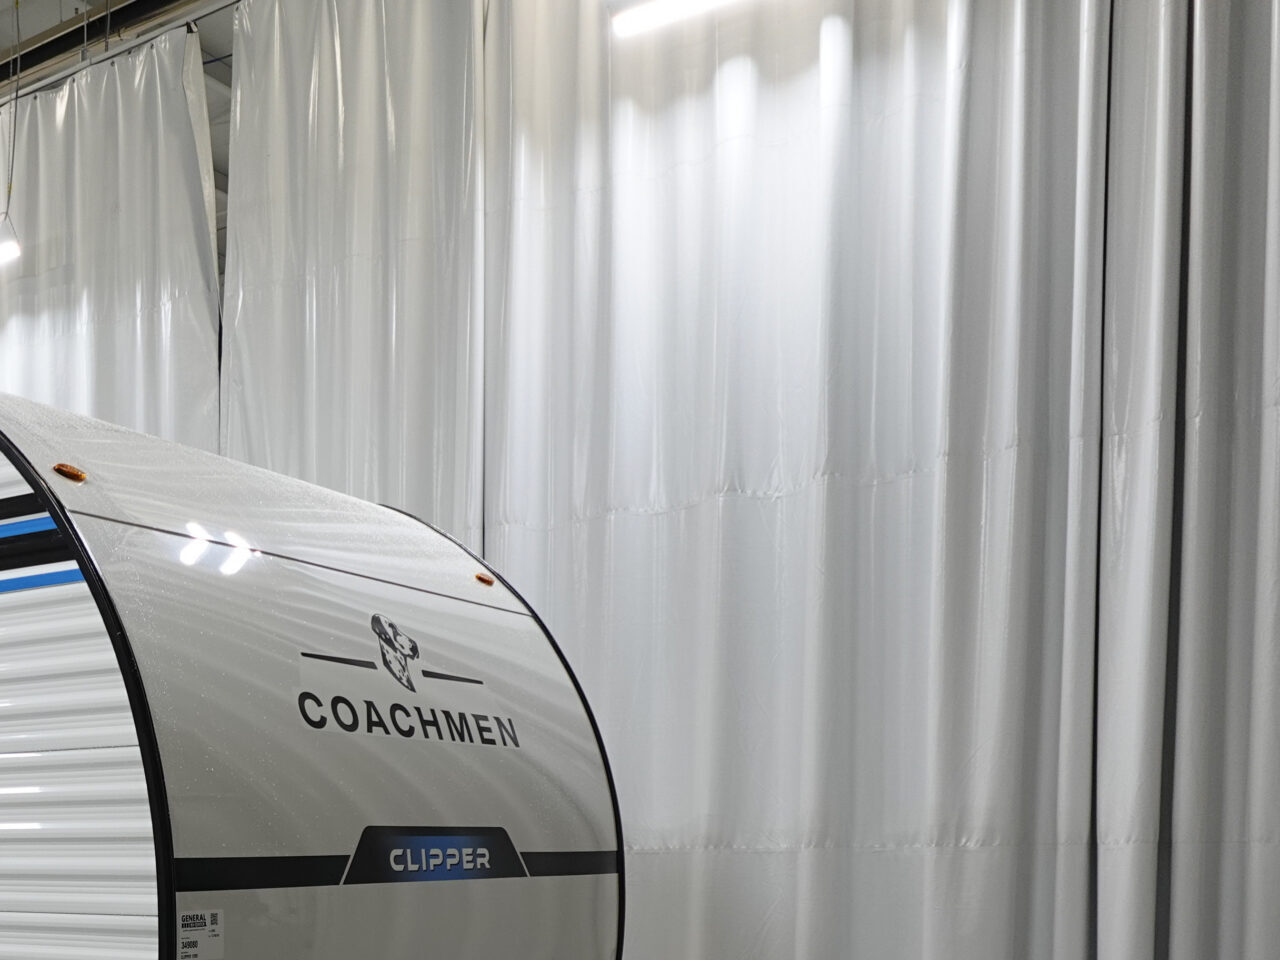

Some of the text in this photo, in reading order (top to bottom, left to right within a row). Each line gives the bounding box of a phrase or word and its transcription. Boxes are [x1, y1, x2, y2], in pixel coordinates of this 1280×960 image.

[298, 691, 520, 748] COACHMEN
[389, 848, 491, 872] CLIPPER
[181, 914, 206, 922] GENERAL
